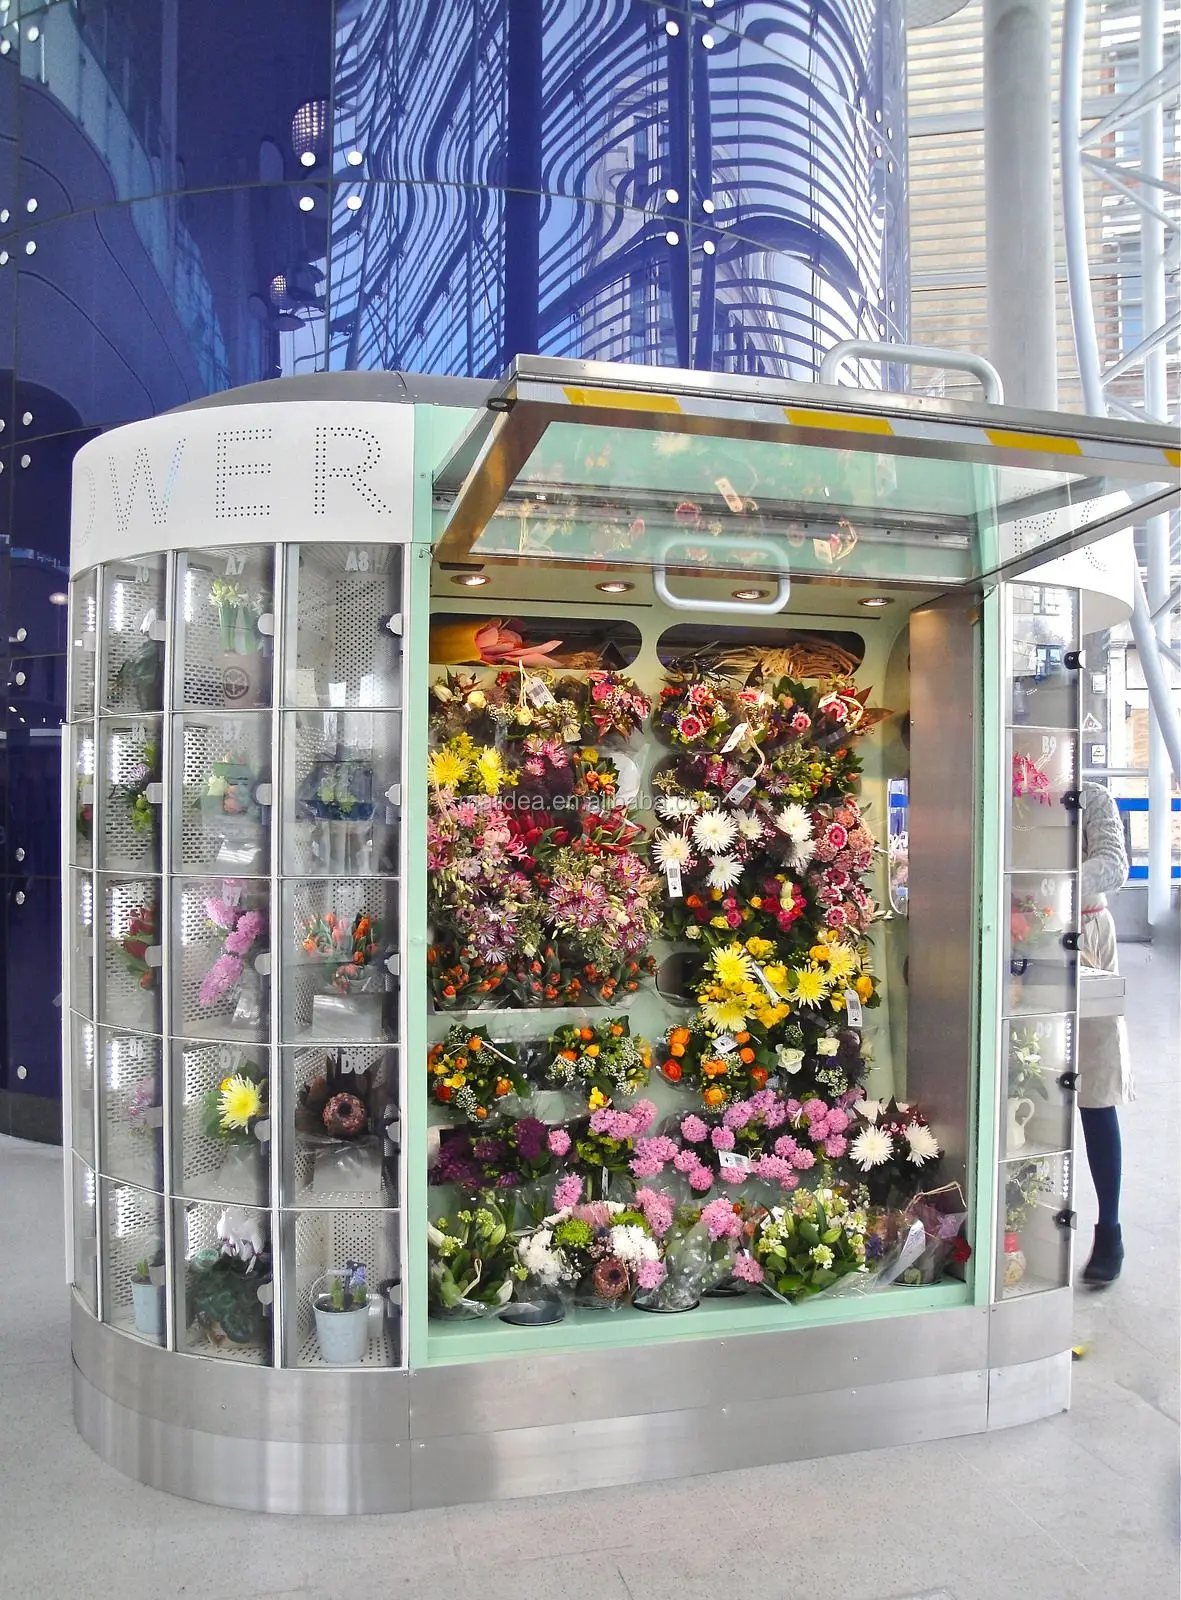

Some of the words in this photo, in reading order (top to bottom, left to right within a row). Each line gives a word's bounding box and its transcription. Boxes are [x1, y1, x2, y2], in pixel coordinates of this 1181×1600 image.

[225, 555, 247, 575] A7
[345, 550, 369, 572] A8
[1042, 736, 1057, 752] B9
